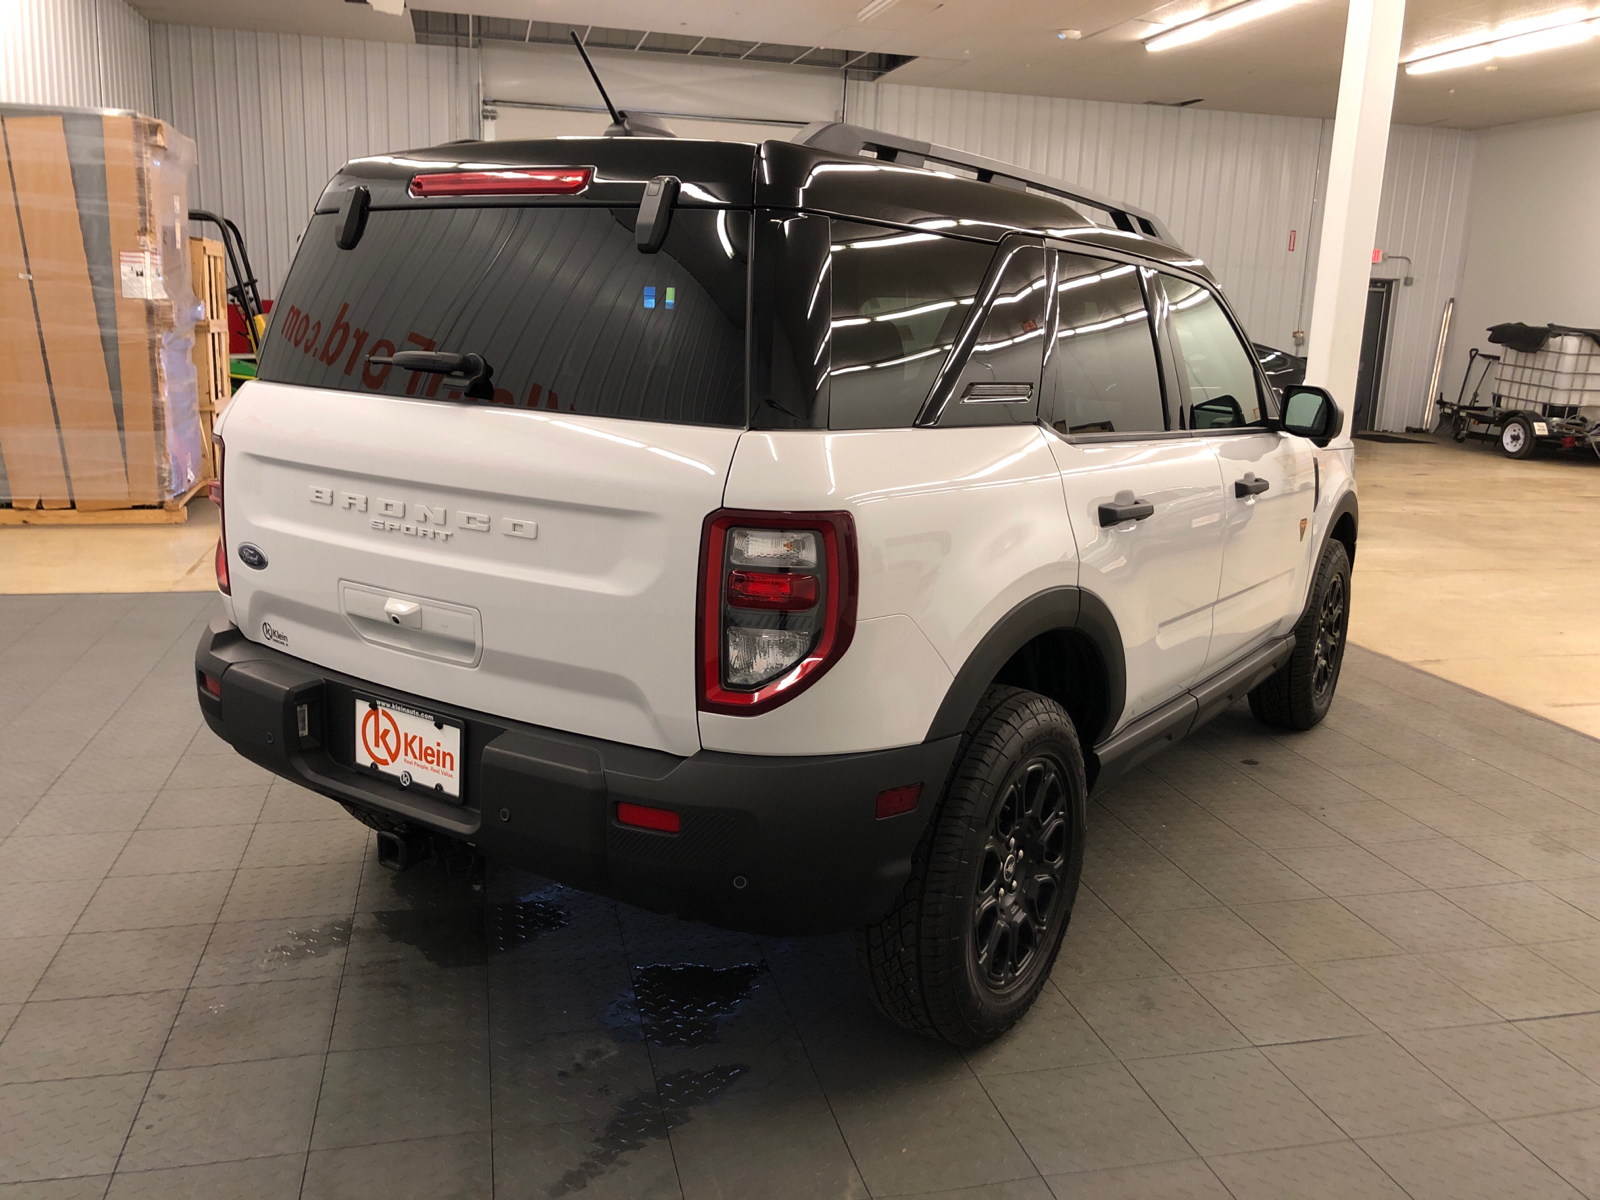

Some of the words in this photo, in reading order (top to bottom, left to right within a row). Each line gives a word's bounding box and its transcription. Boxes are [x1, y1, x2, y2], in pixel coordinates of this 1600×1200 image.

[308, 485, 538, 539] BRONCO
[370, 518, 453, 541] SPORT
[272, 628, 289, 643] Klein
[376, 700, 434, 721] www.kleinauto.com
[403, 732, 454, 772] Klein
